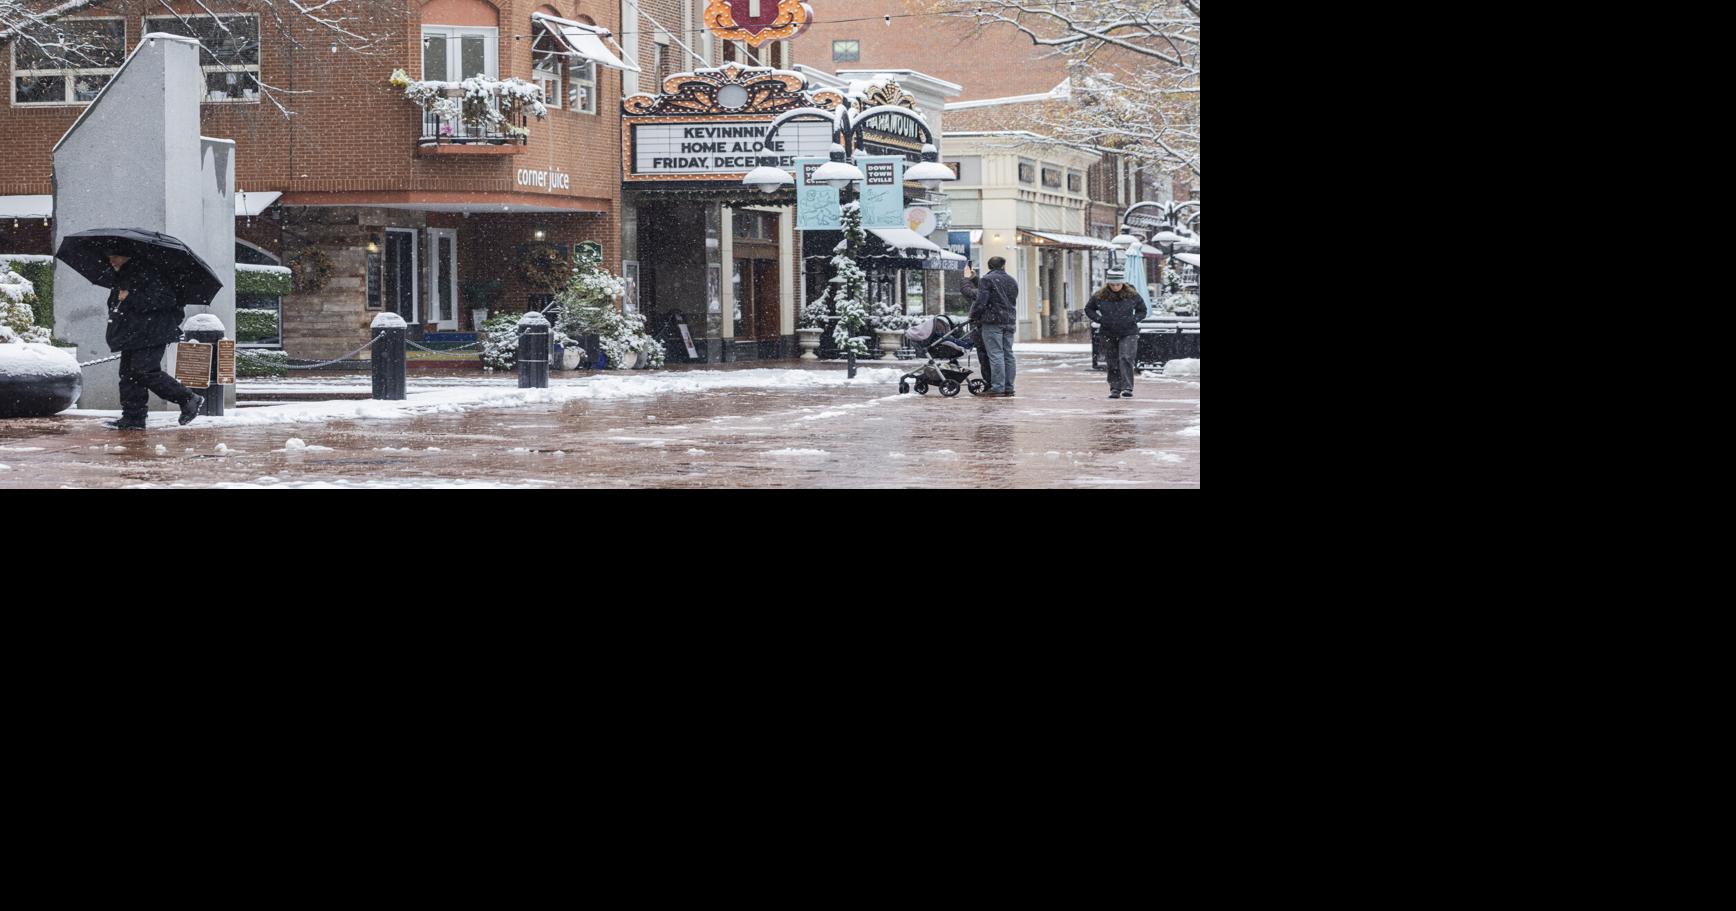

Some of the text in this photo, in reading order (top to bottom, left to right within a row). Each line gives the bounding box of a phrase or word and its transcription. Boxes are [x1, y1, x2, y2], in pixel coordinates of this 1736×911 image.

[681, 142, 727, 153] HOME
[653, 157, 709, 169] FRIDAY,
[517, 166, 569, 192] corner juice
